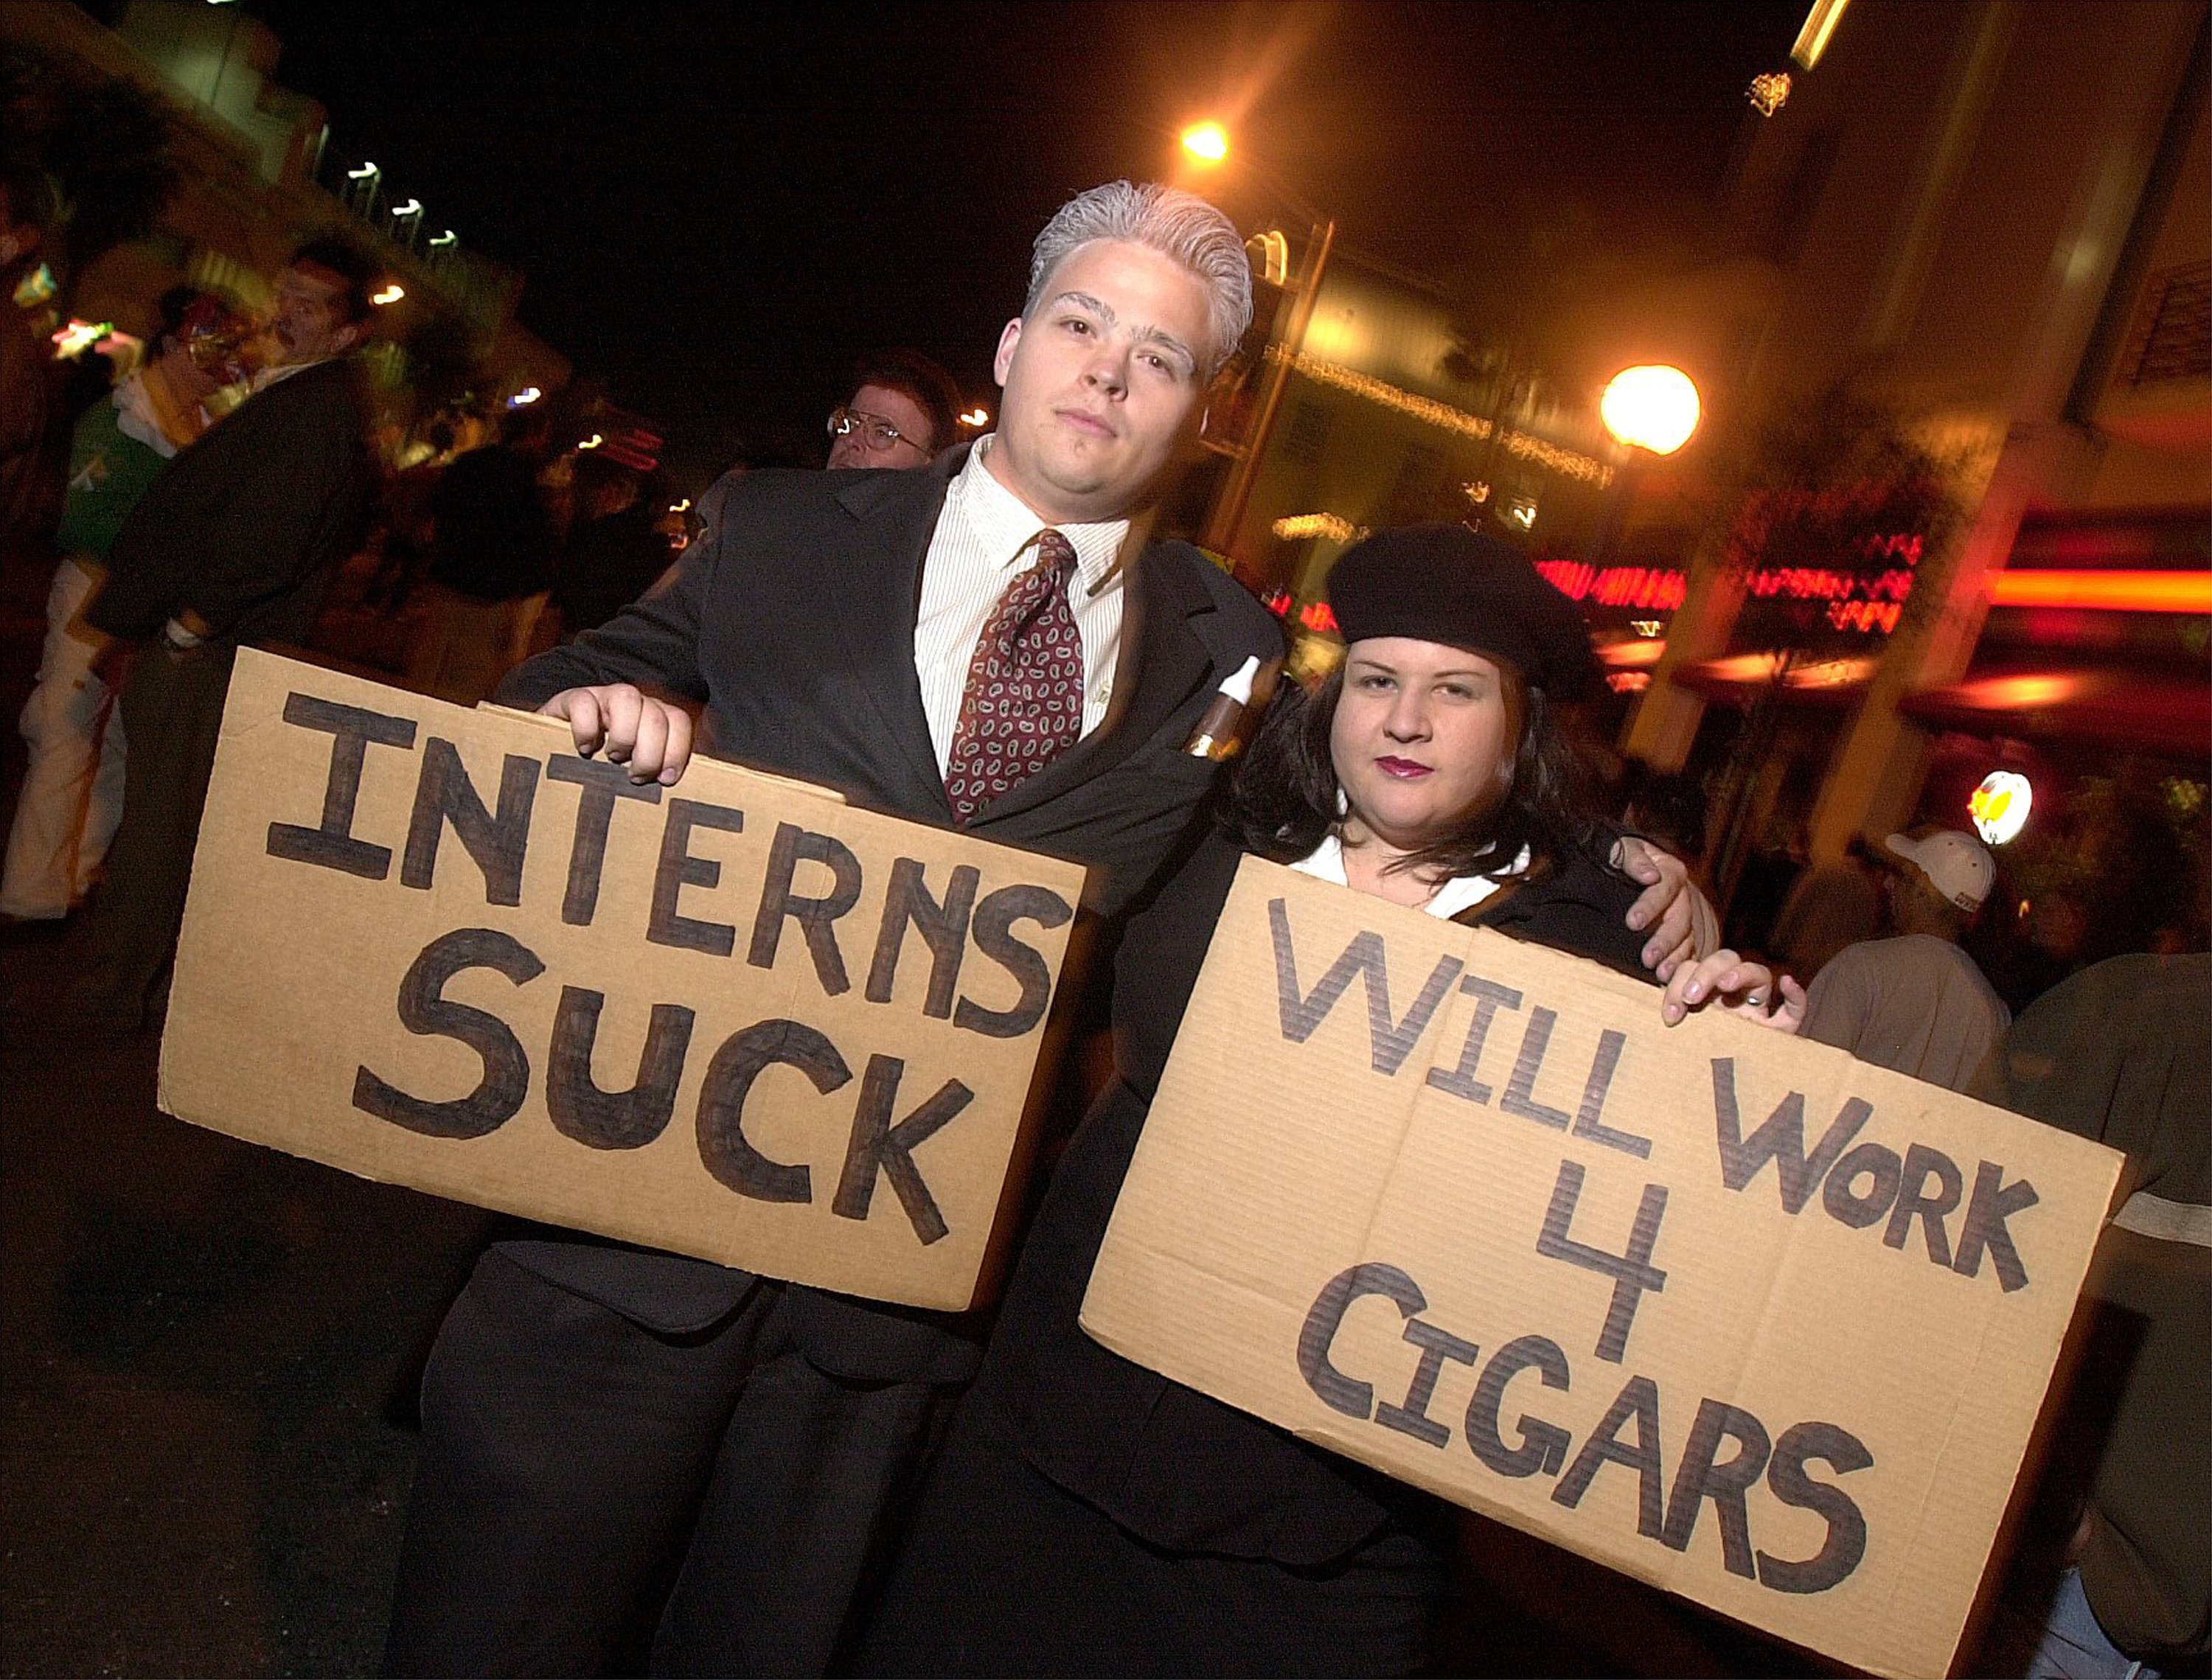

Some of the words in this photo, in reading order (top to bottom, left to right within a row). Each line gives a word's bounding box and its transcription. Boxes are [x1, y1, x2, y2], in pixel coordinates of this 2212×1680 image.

[266, 691, 1073, 1038] INTERNS
[351, 928, 975, 1246] SUCK
[1268, 896, 1652, 1160] WILL
[1710, 1056, 2039, 1292] WORK
[1536, 1159, 1668, 1363] 4
[1296, 1263, 1874, 1594] CIGARS
